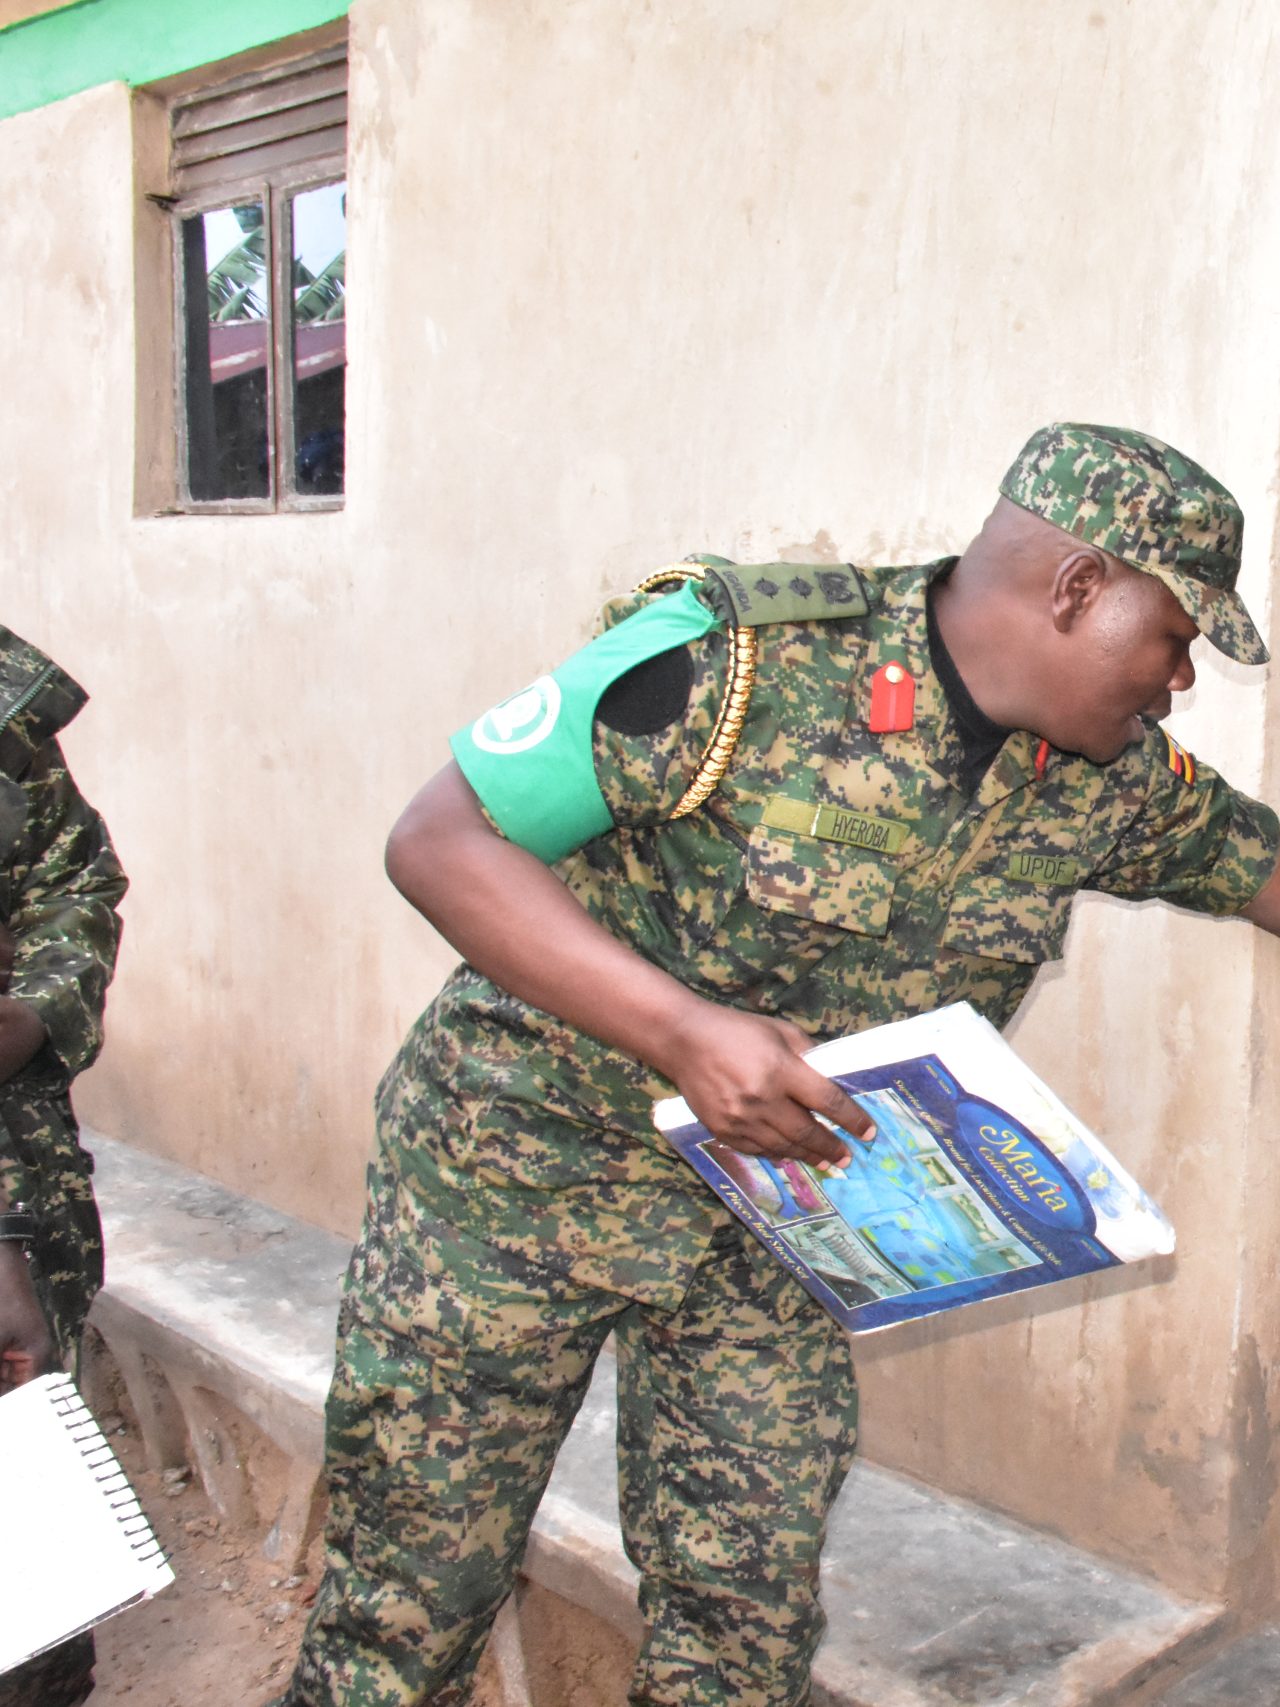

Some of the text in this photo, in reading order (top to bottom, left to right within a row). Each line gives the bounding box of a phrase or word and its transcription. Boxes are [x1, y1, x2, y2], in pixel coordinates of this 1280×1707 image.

[832, 811, 890, 850] HYEROBA
[1020, 856, 1067, 881] UPDF
[893, 1079, 922, 1110] Superior
[943, 1138, 967, 1164] Brand
[979, 1147, 1030, 1203] Collection
[980, 1125, 1068, 1213] Maria
[725, 1192, 752, 1219] Pieces
[752, 1222, 775, 1239] Bed
